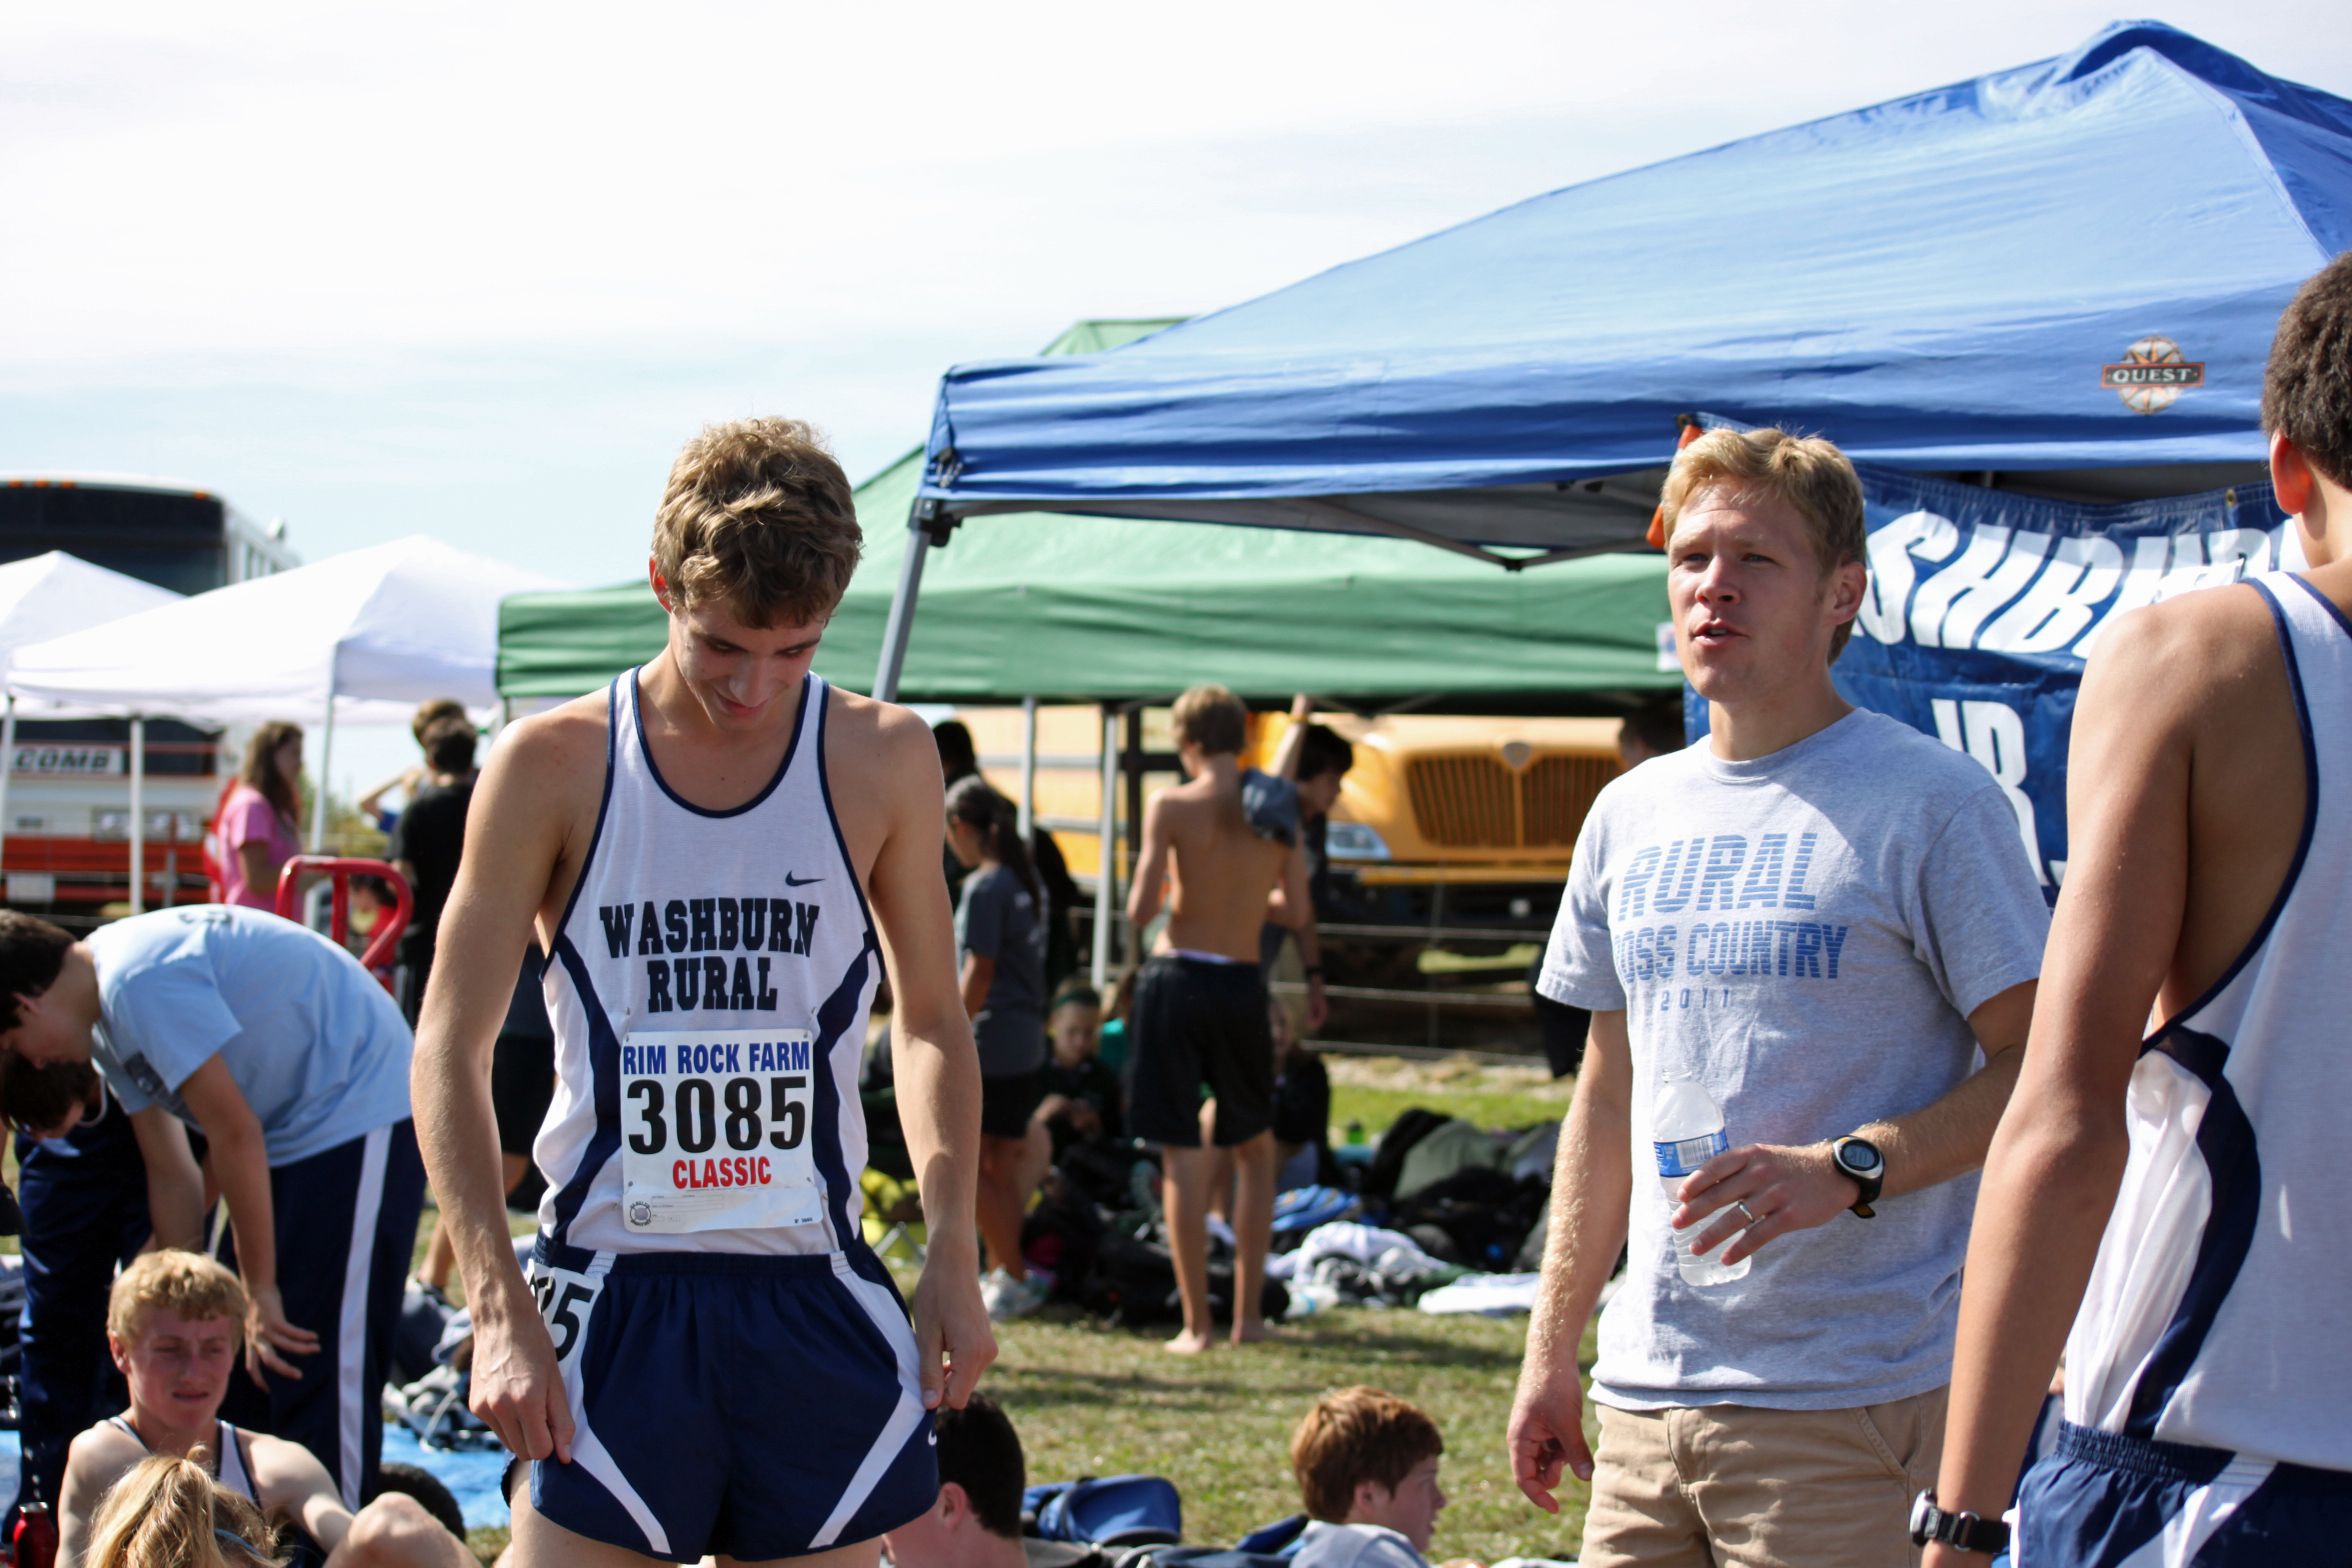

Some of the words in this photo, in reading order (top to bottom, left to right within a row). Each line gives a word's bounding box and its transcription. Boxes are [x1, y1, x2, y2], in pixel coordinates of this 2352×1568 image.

[2111, 367, 2193, 384] QUEST
[1617, 832, 1819, 923] RURAL
[599, 897, 820, 959] WASHBURN
[1686, 919, 1849, 979] COUNTRY
[646, 956, 778, 1013] RURAL
[1659, 987, 1730, 1011] 2011
[623, 1045, 667, 1075] RIM
[677, 1043, 740, 1073] ROCK
[748, 1041, 810, 1072] FARM
[626, 1076, 807, 1155] 3085
[672, 1156, 773, 1189] CLASSIC
